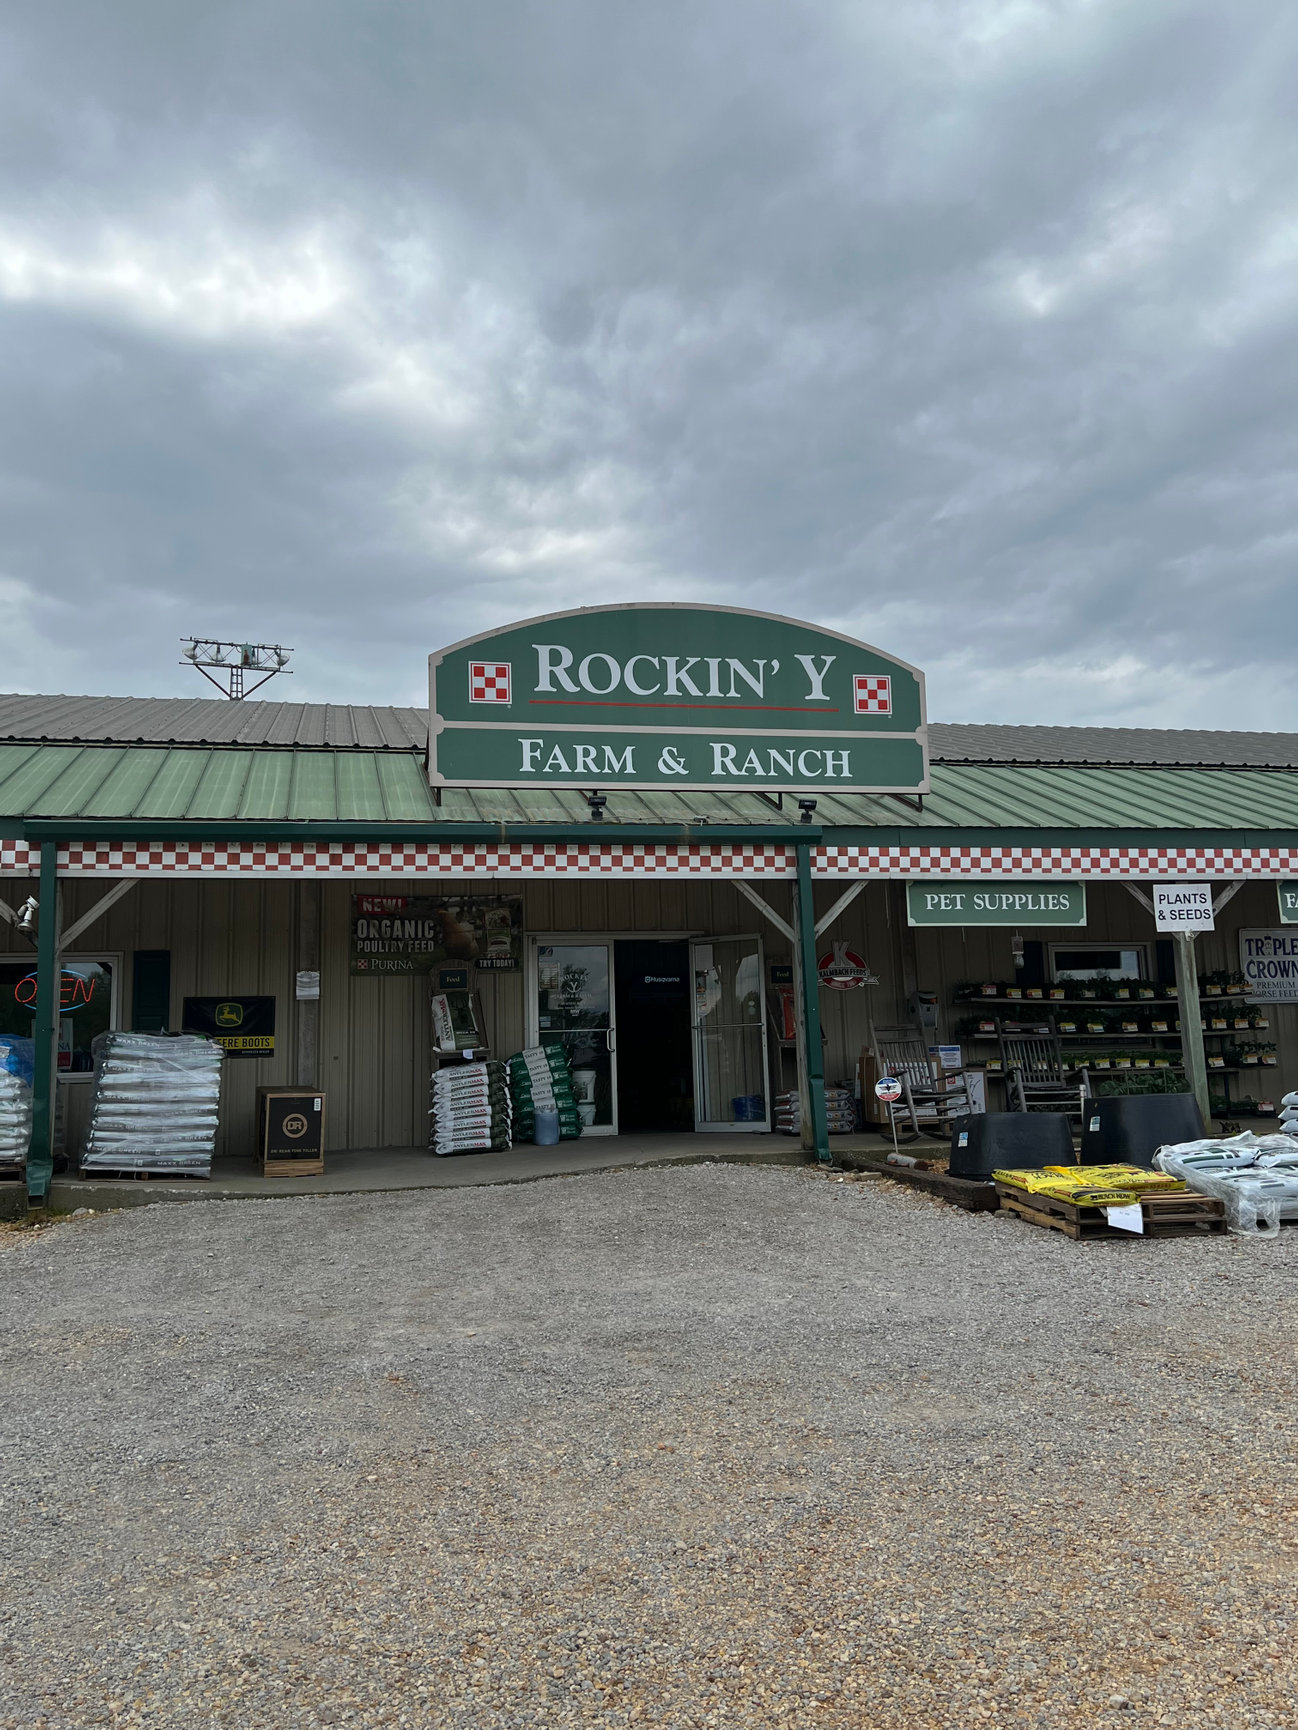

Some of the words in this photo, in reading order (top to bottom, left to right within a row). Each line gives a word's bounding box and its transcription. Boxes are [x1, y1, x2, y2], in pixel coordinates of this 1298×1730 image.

[532, 644, 780, 700] ROCKIN'
[794, 654, 837, 701] Y
[518, 738, 637, 775] FARM
[657, 747, 690, 776] &
[710, 742, 853, 778] RANCH
[363, 898, 402, 912] NEW!
[925, 893, 965, 910] PET
[973, 893, 1070, 910] SUPPLIES
[1158, 893, 1207, 905] PLANTS
[1157, 910, 1167, 921] &
[1169, 908, 1212, 921] SEEDS
[357, 919, 435, 939] ORGANIC
[357, 940, 405, 953] POULTRY
[408, 940, 435, 953] FEED
[370, 959, 414, 971] PURINA
[479, 959, 492, 968] TRY
[492, 959, 515, 968] TODAY!
[14, 977, 96, 1003] OEN
[1256, 981, 1296, 989] PREMIUM
[217, 1038, 239, 1048] ERE
[242, 1037, 270, 1048] BOOTS
